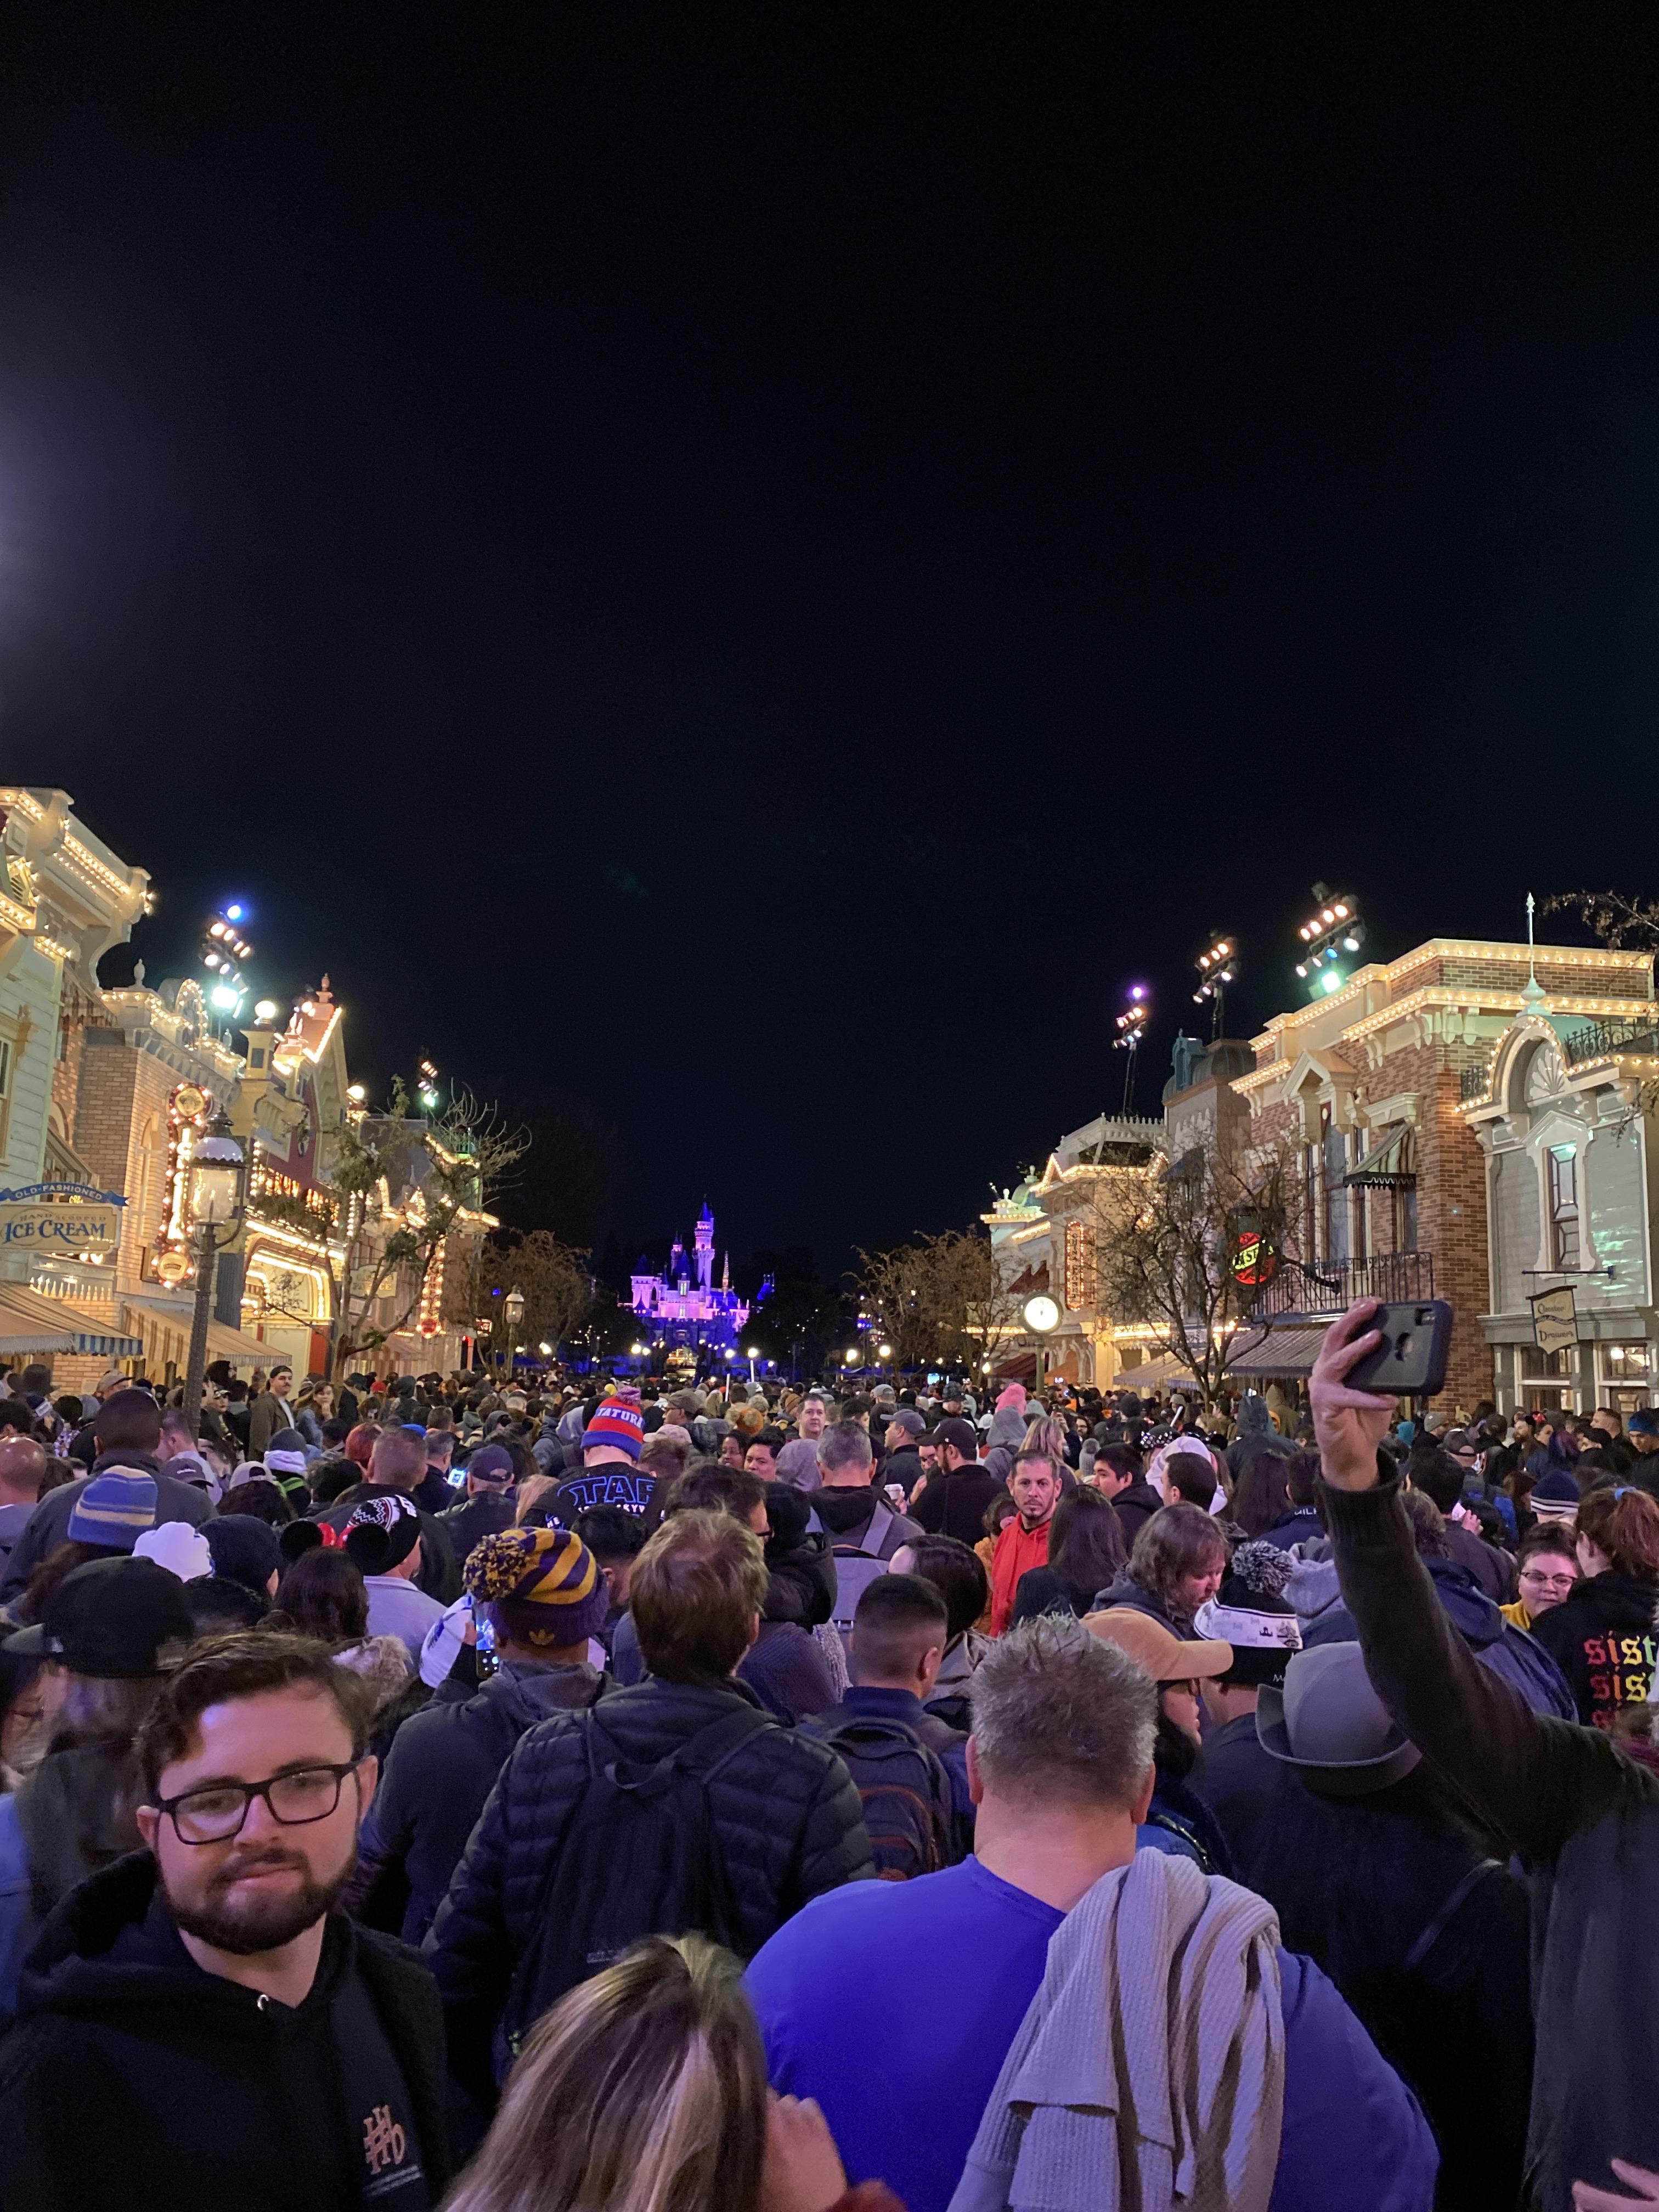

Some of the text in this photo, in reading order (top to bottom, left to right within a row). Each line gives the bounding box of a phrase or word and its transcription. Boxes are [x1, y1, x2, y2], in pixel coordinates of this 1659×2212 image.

[15, 1184, 103, 1200] OLD-FASHIONED
[20, 1213, 53, 1222] HAND
[2, 1220, 107, 1245] ICE CREAM
[1584, 1630, 1656, 1668] sist
